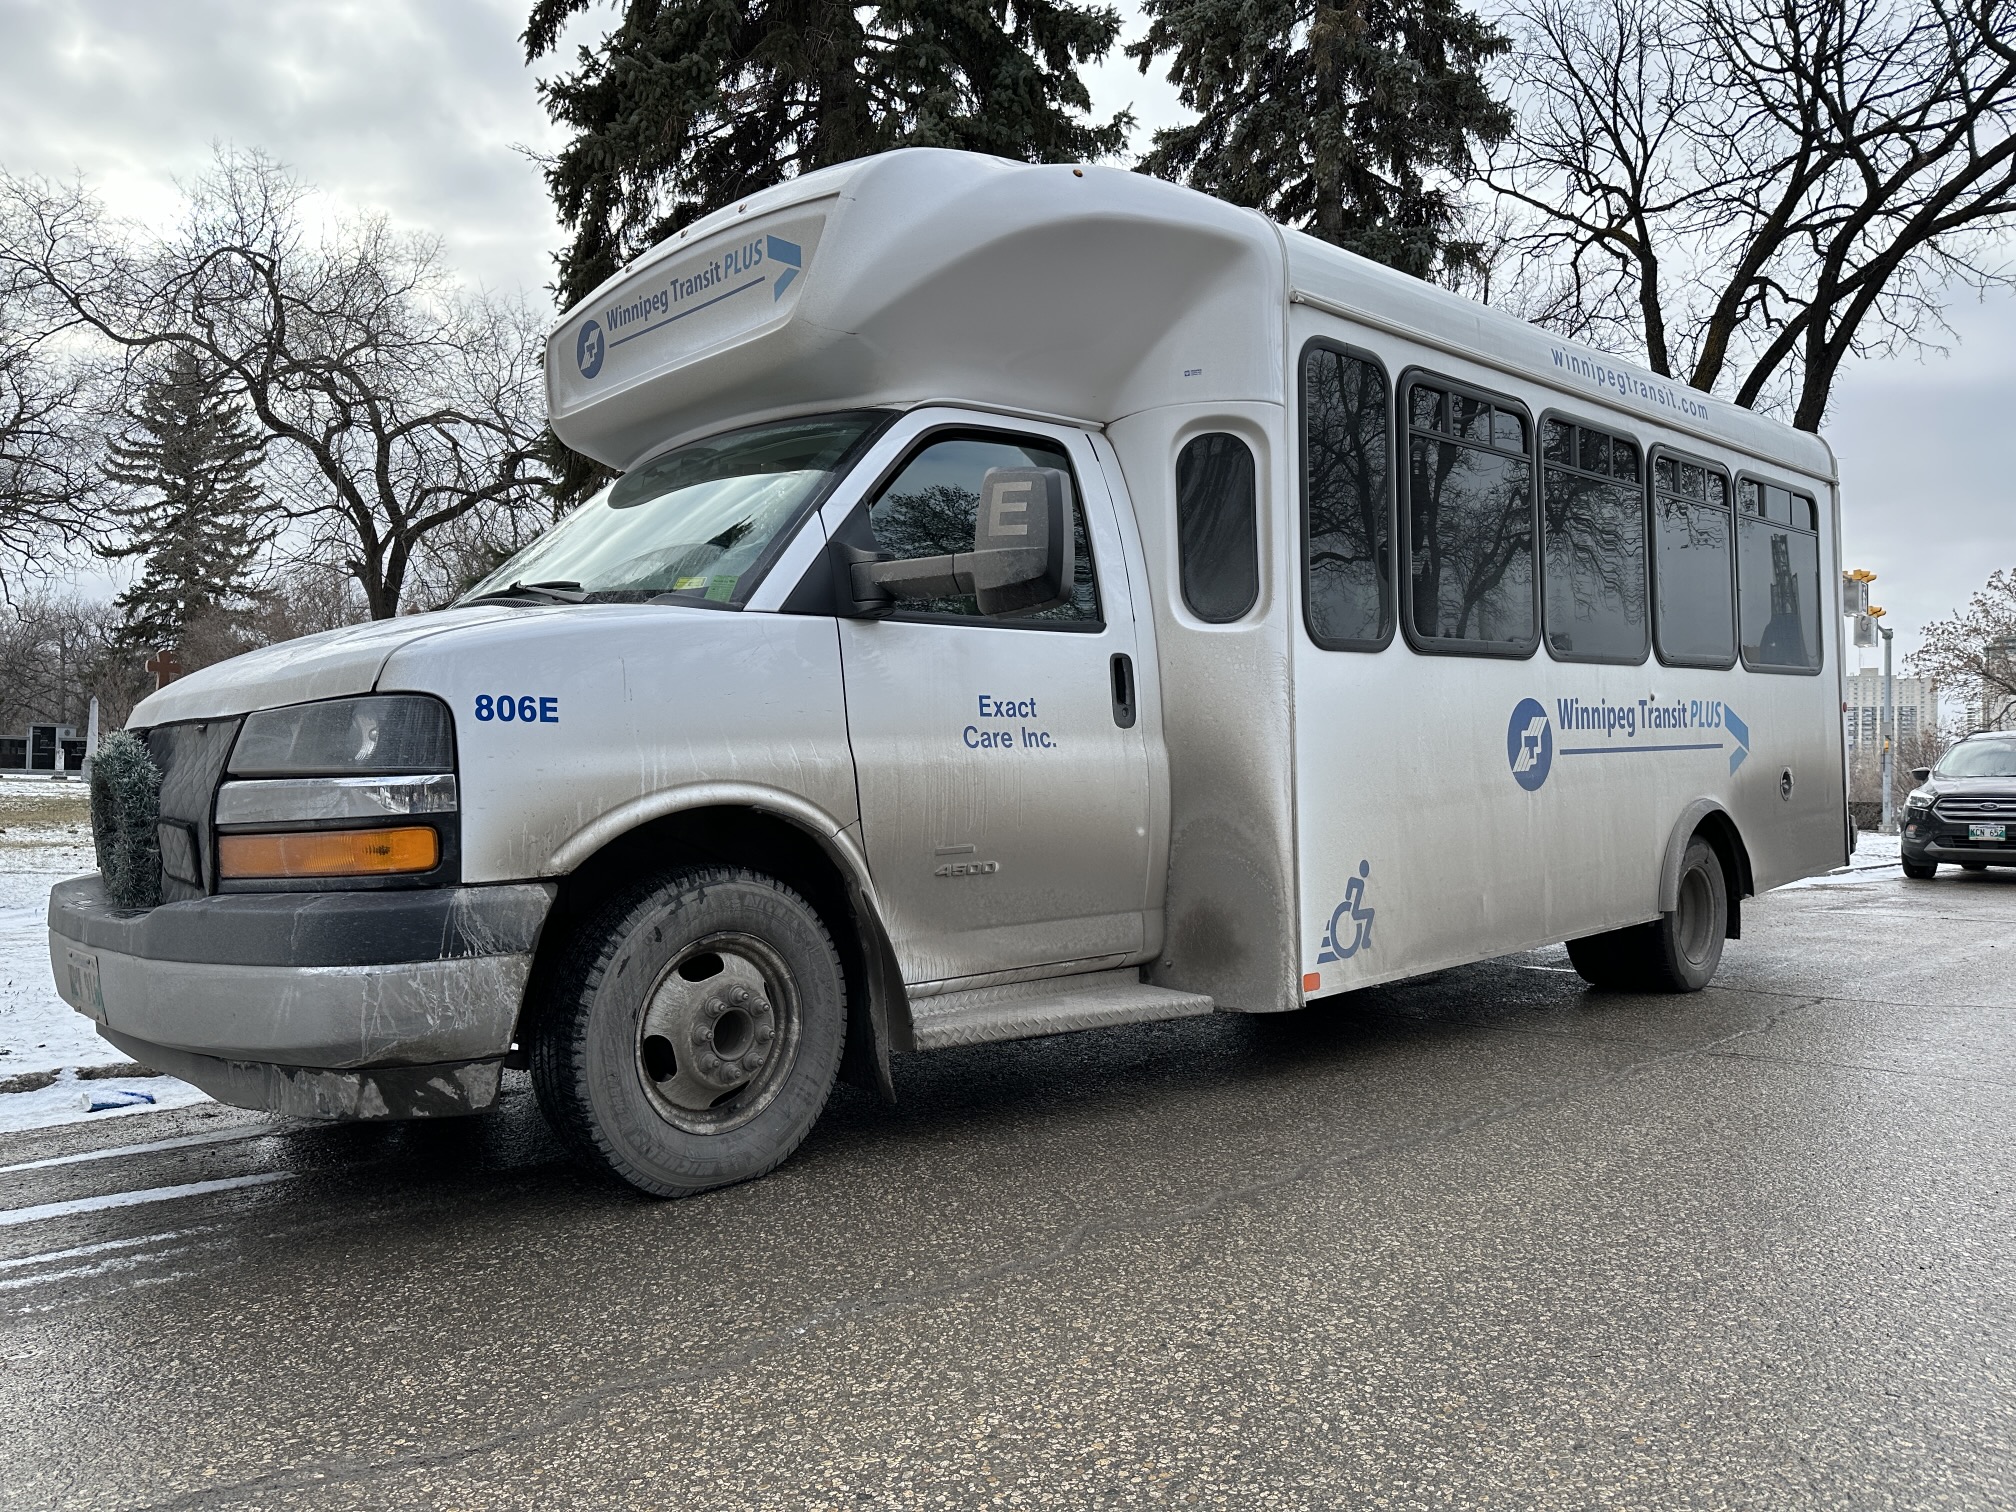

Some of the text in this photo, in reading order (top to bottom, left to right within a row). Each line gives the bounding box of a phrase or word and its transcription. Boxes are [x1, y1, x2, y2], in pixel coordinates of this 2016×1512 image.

[606, 238, 763, 332] Winnipeg Transit PLUS
[1550, 347, 1709, 421] winnipegtransit.com
[988, 481, 1033, 537] E
[475, 694, 559, 723] 806E
[978, 695, 1037, 718] Exact
[1556, 697, 1722, 738] Winnipeg Transit PLUS
[963, 725, 1057, 749] Care Inc.
[935, 861, 999, 877] 4500
